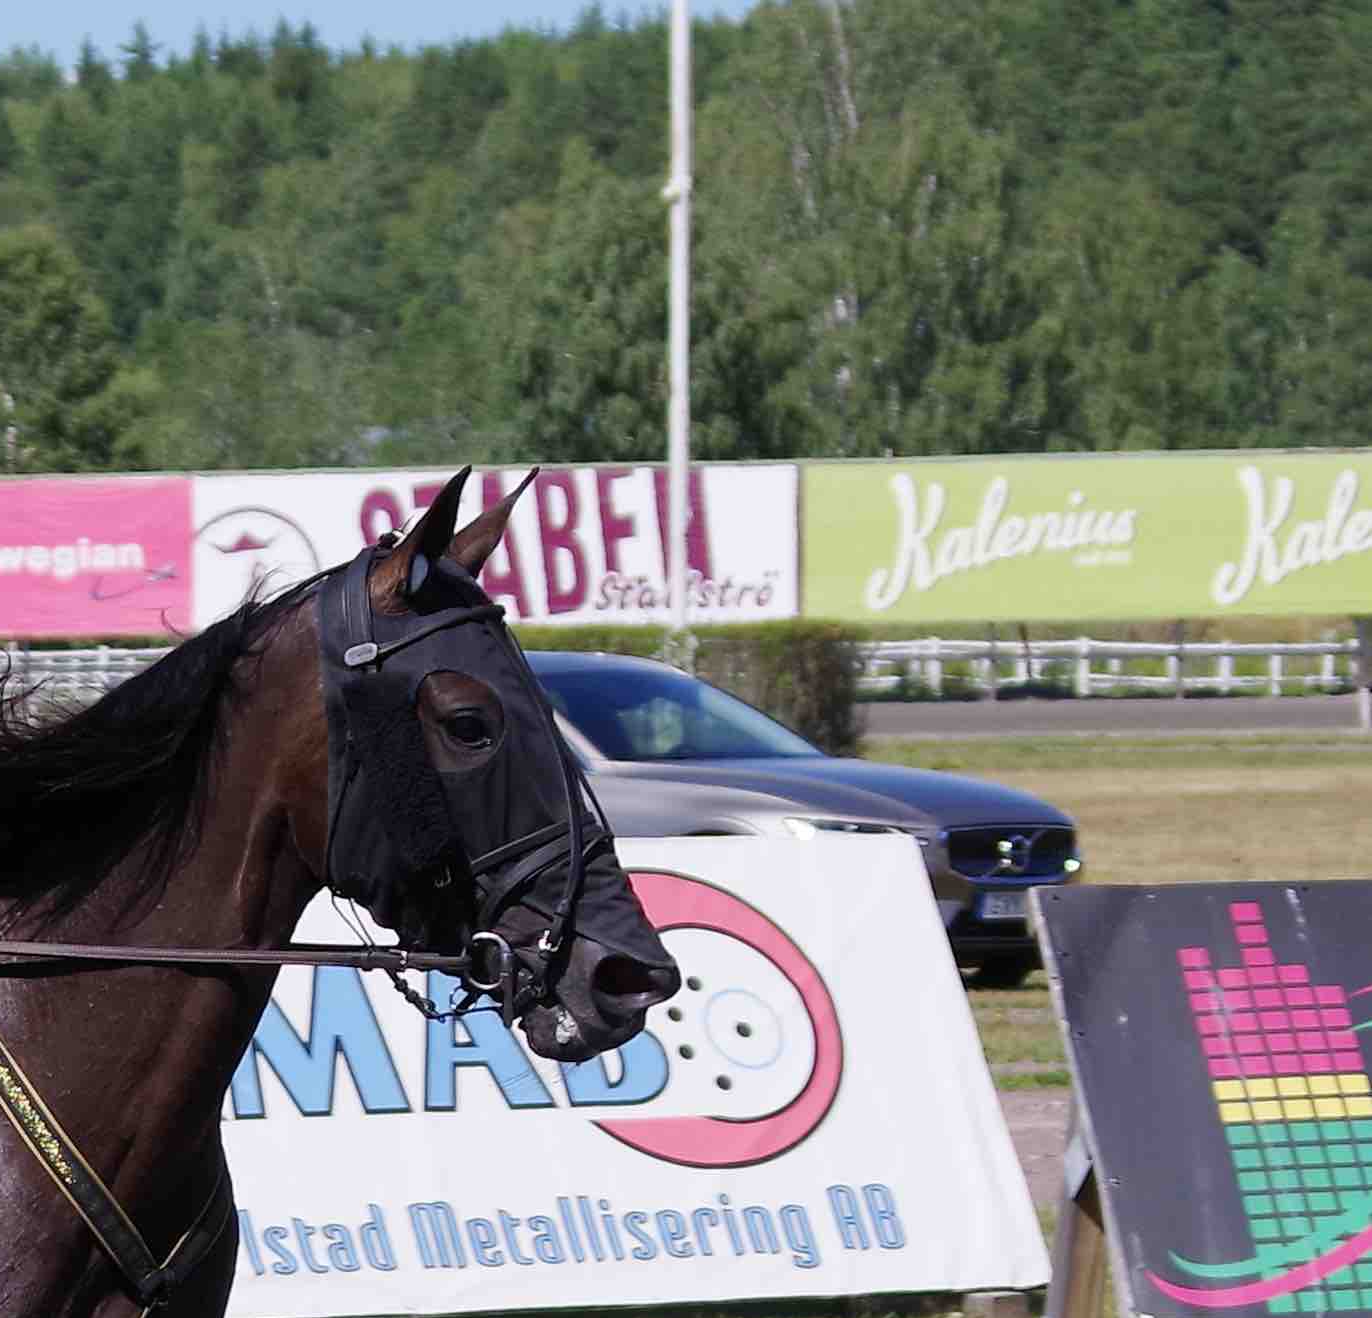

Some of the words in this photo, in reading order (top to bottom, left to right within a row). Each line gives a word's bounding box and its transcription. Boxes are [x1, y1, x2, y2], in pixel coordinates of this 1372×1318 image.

[865, 472, 1137, 611] Kalenius
[407, 1194, 822, 1269] Metallisering
[826, 1184, 907, 1251] AB
